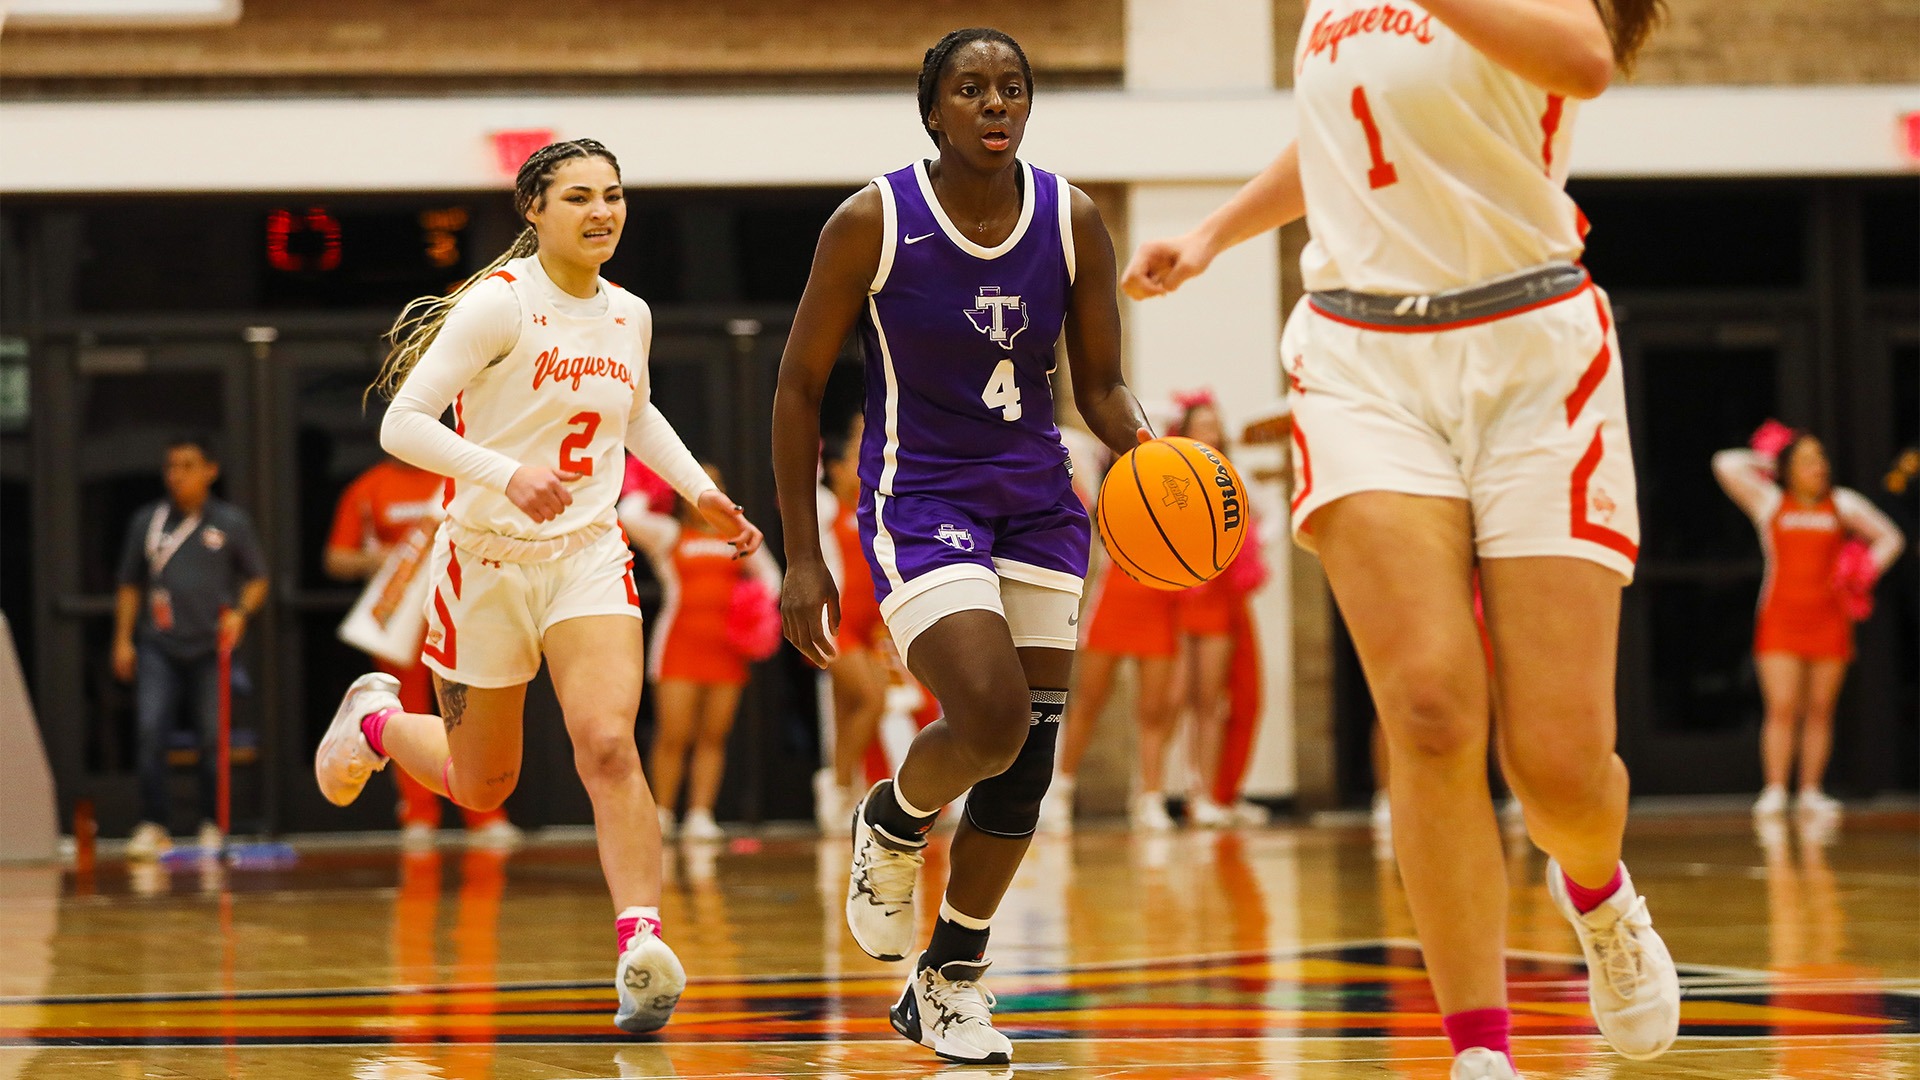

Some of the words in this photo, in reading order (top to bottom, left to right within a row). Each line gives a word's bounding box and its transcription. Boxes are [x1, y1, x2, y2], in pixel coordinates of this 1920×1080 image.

[1351, 85, 1399, 190] 1
[974, 294, 1022, 342] T
[981, 358, 1022, 421] 4
[559, 411, 602, 476] 2
